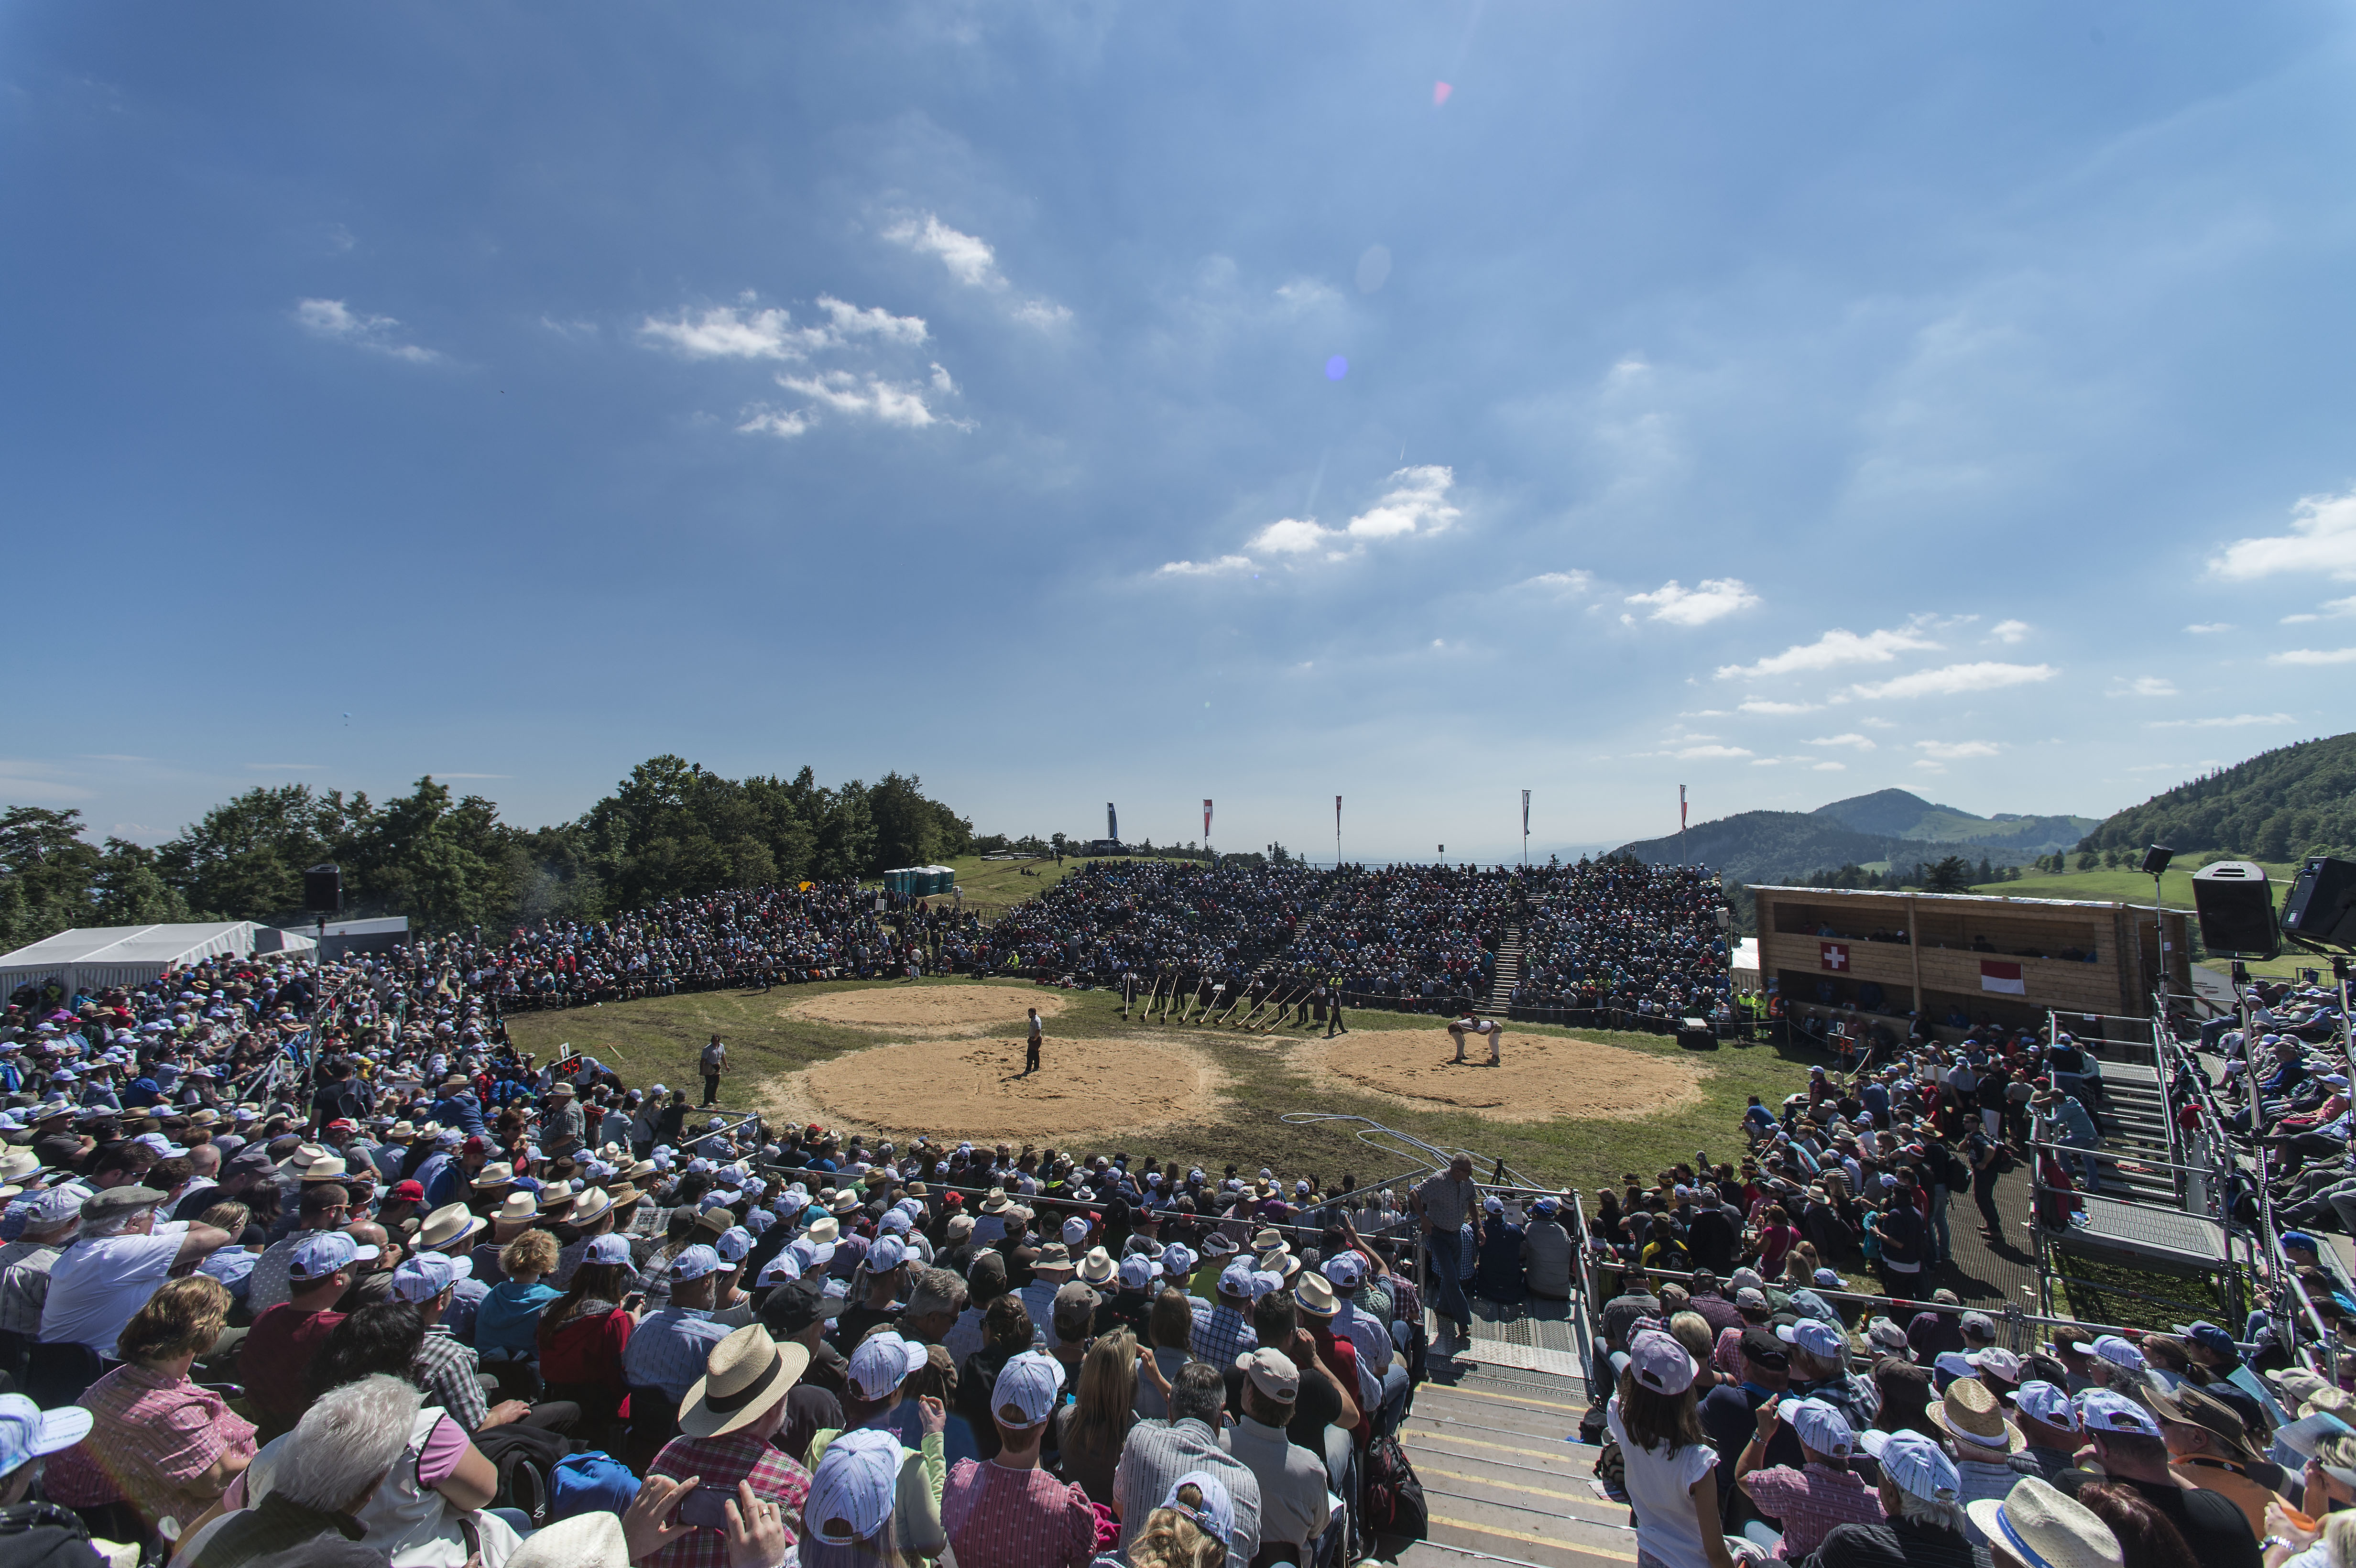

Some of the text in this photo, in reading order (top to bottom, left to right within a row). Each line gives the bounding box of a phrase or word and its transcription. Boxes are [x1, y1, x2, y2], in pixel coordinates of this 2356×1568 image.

[1838, 1024, 1843, 1035] 2
[563, 1045, 568, 1058] 1
[563, 1058, 579, 1075] 45
[1178, 1503, 1194, 1516] MIGROS
